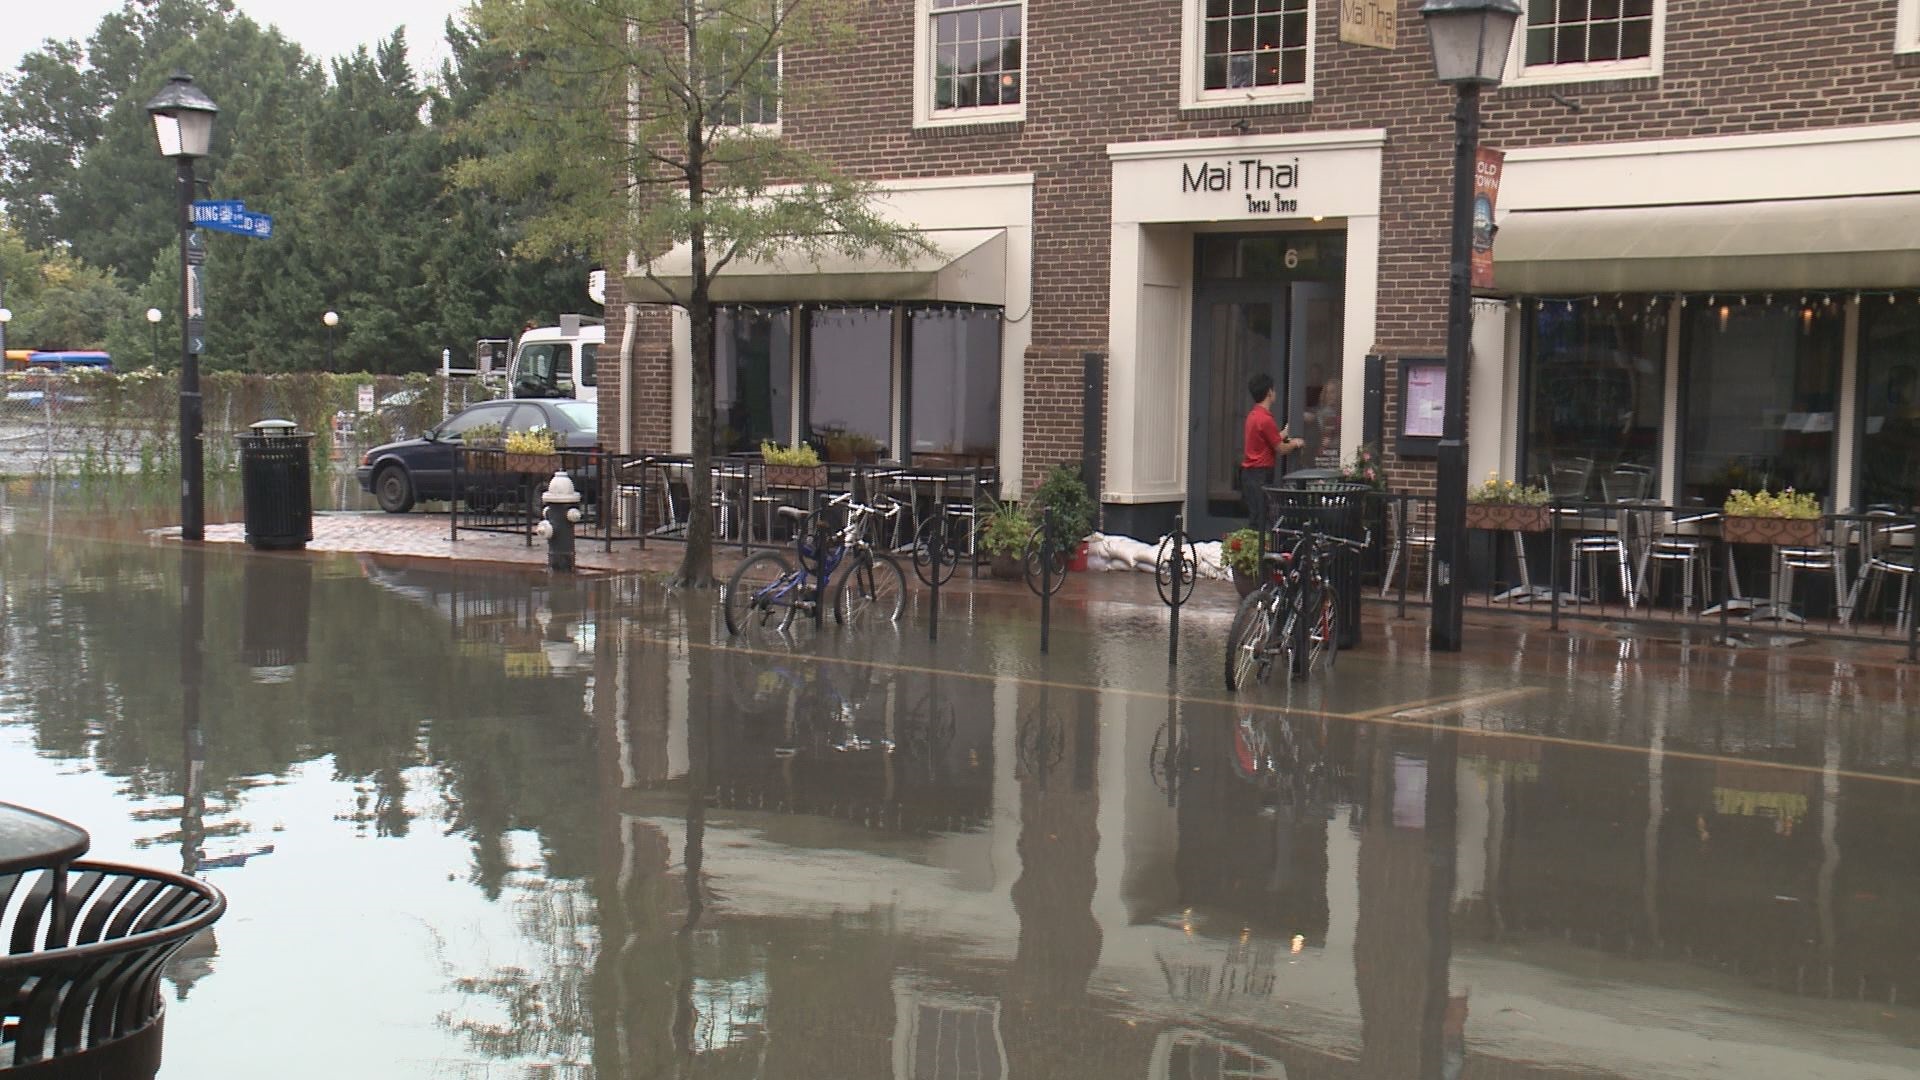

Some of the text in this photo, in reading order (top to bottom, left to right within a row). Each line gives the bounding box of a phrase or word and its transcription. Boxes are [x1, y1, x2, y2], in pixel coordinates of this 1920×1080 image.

[1342, 0, 1395, 30] Mai Thai
[1182, 157, 1299, 193] Mai Thai
[1477, 161, 1497, 175] OLD
[193, 205, 218, 222] KING
[1285, 248, 1298, 269] 6
